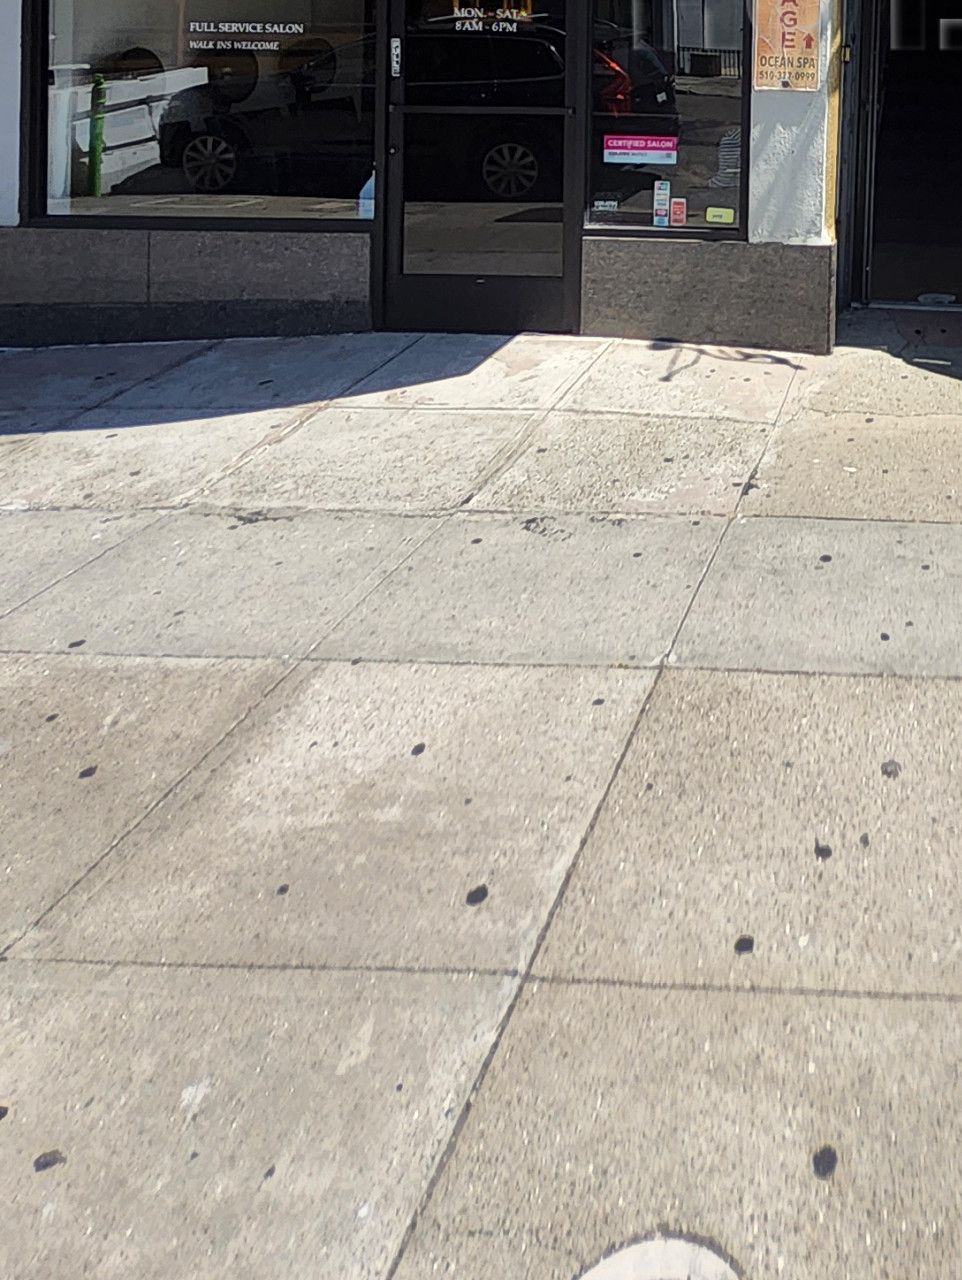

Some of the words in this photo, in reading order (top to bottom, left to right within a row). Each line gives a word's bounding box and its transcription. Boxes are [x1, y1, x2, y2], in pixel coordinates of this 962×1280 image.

[189, 22, 217, 32] FULL
[219, 22, 263, 33] SERVICE
[265, 23, 304, 33] SALON
[491, 22, 517, 32] 6PM
[189, 40, 215, 49] WALK
[216, 41, 232, 49] INS
[233, 41, 280, 50] WELCOME
[760, 55, 794, 68] OCEAN
[796, 57, 816, 69] SPA
[608, 139, 645, 148] CERTIFIED
[647, 140, 673, 148] SALON
